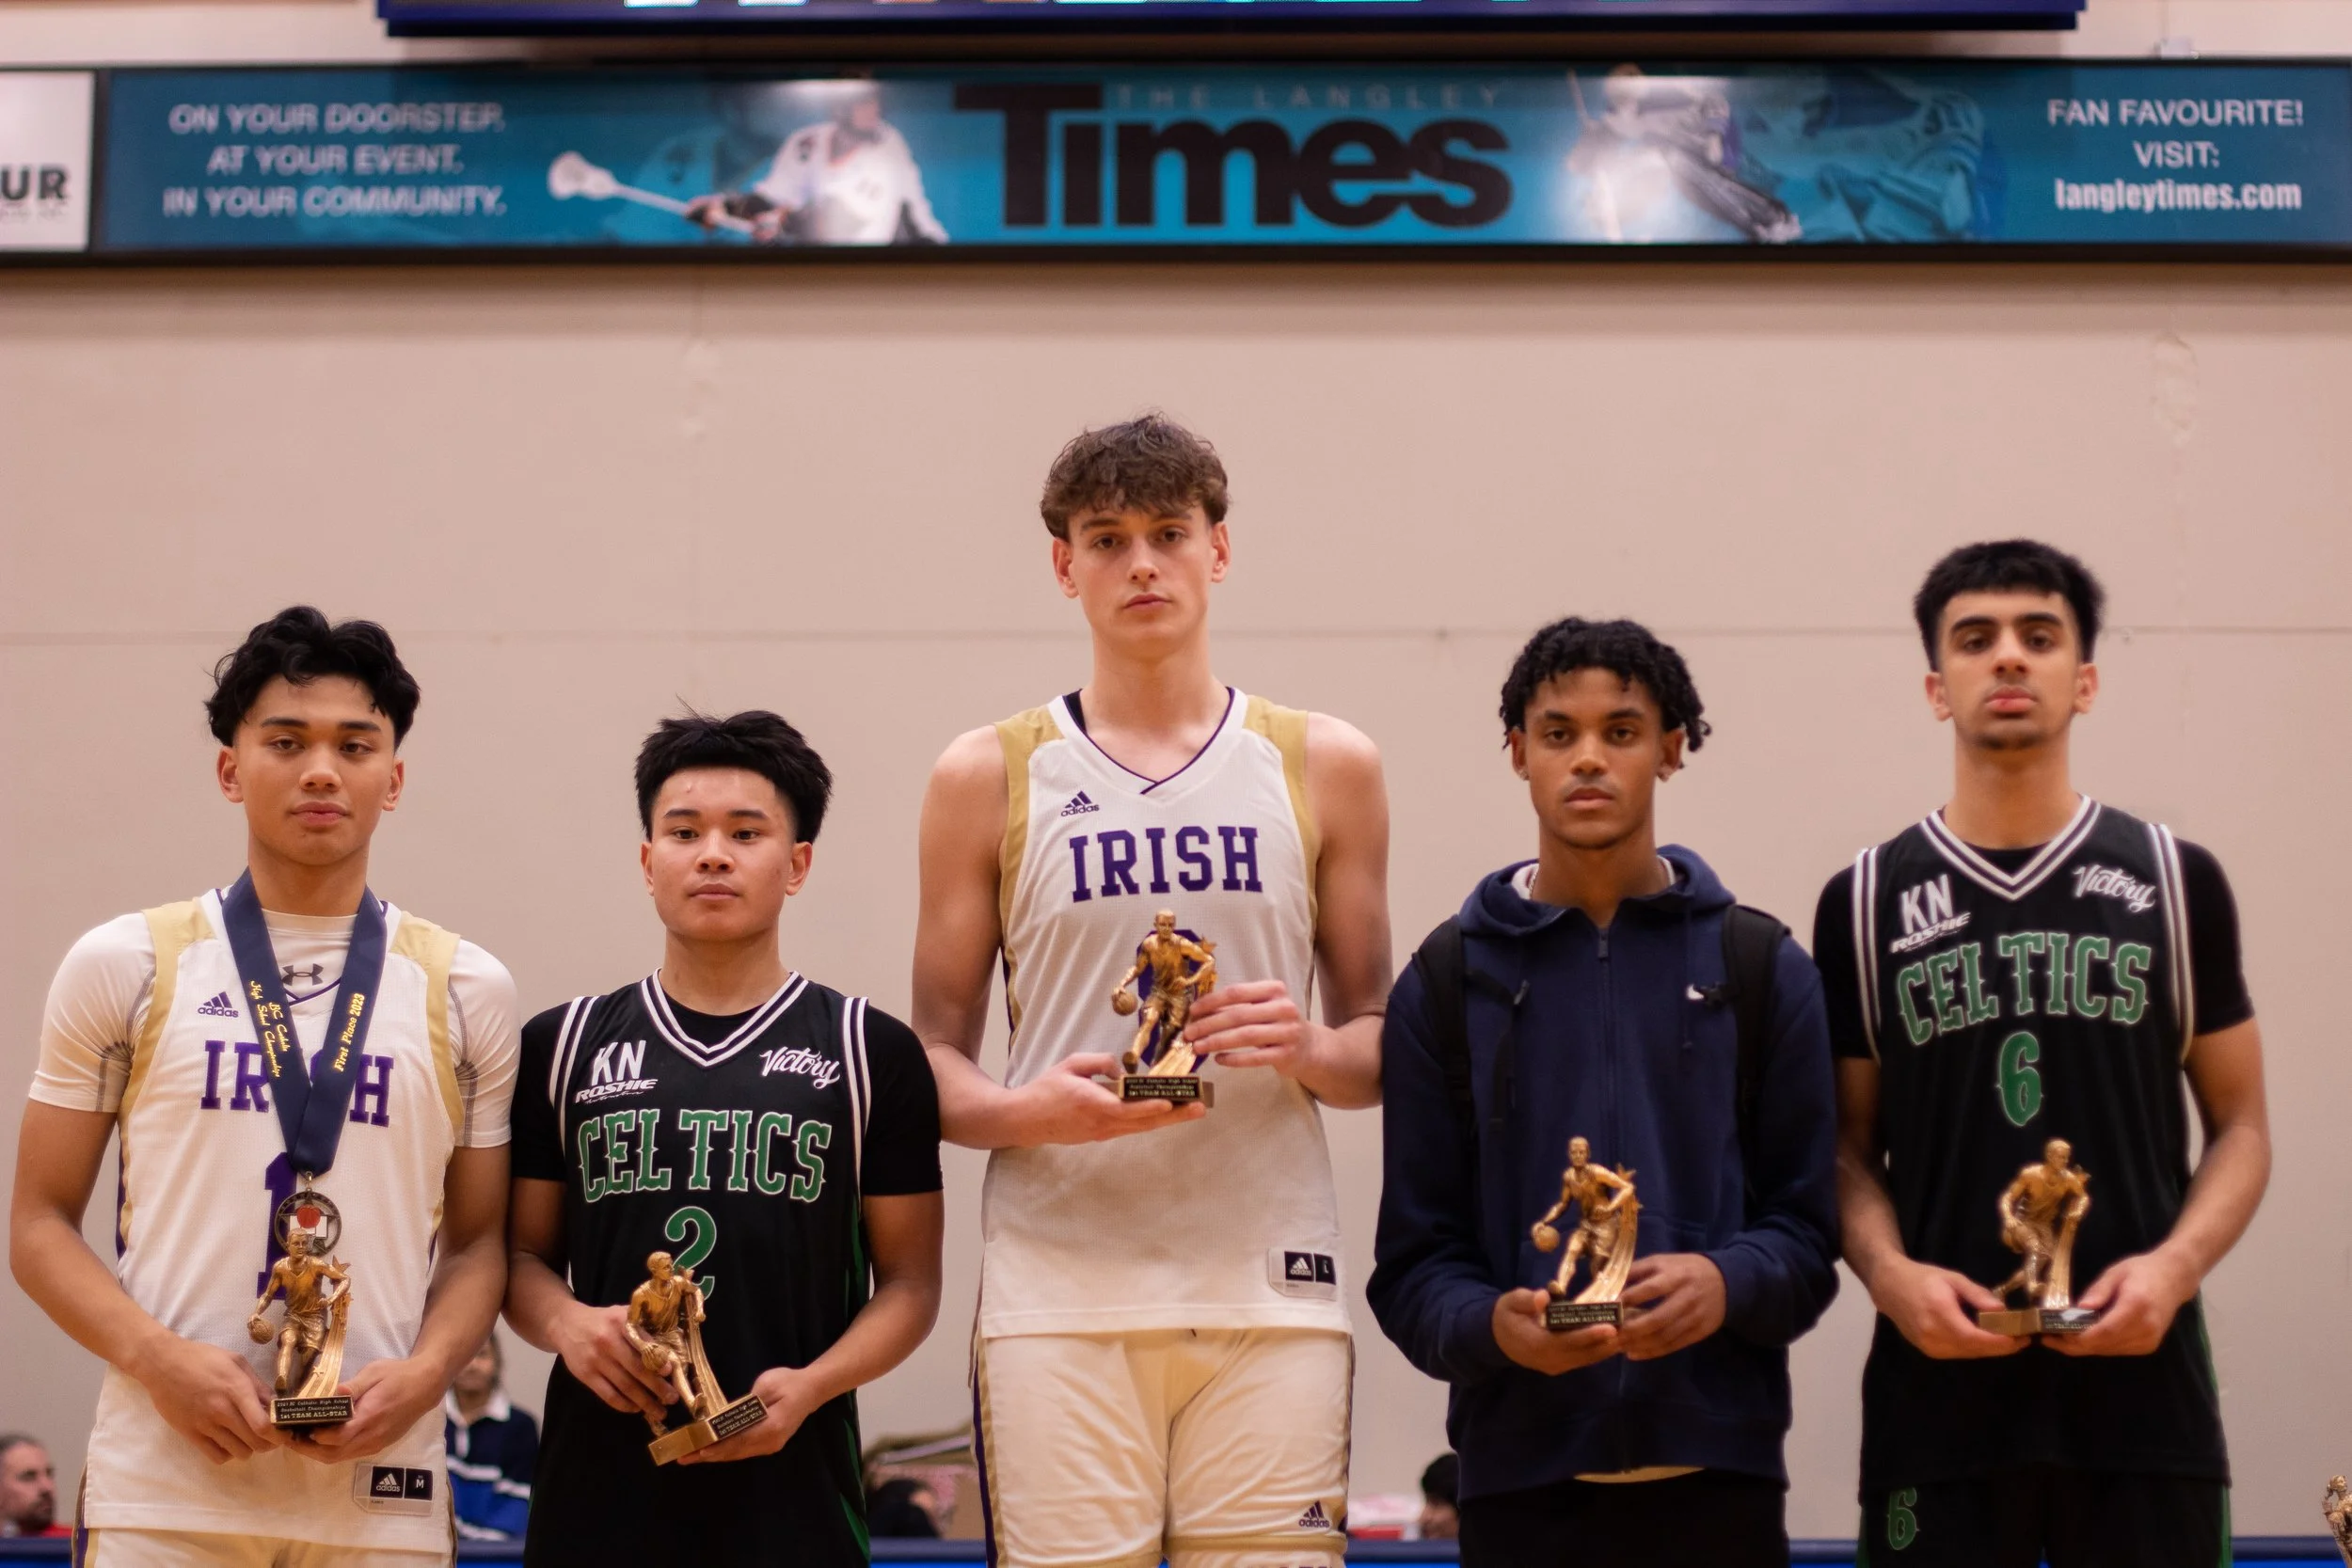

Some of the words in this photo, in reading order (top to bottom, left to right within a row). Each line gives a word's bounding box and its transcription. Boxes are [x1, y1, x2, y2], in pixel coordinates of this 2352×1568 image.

[1119, 84, 1211, 109] THE
[1253, 84, 1502, 109] LANGLEY
[2048, 99, 2109, 126] FAN
[2119, 99, 2305, 126] FAVOURITE!
[168, 103, 219, 134] ON
[227, 103, 319, 134] YOUR
[325, 103, 506, 134] DOORSTEP.
[206, 144, 249, 176] AT
[255, 144, 347, 176] YOUR
[354, 144, 464, 175] EVENT.
[954, 83, 1514, 230] Times
[2133, 140, 2220, 168] VISIT:
[0, 165, 69, 200] UR
[2055, 178, 2302, 214] langleytimes.com
[163, 185, 198, 218] IN
[204, 185, 297, 218] YOUR
[303, 185, 508, 218] COMMUNITY.
[1061, 803, 1100, 817] adidas
[1069, 825, 1263, 903] IRISH
[2073, 863, 2156, 912] Victory
[1900, 873, 1954, 935] KN
[1889, 911, 1972, 953] ROSHIE
[349, 992, 365, 1017] 2023
[1897, 932, 2153, 1045] CELTICS
[197, 1006, 239, 1018] adidas
[268, 1002, 284, 1020] BC
[342, 1017, 358, 1045] Place
[334, 1046, 349, 1072] First
[591, 1039, 647, 1086] KN
[759, 1046, 841, 1089] Victory
[201, 1039, 394, 1128] IRH
[575, 1079, 659, 1103] ROSHIE
[1995, 1031, 2044, 1127] 6
[578, 1108, 833, 1203] CELTICS
[664, 1206, 718, 1301] 2
[1290, 1268, 1312, 1276] adidas
[376, 1484, 401, 1493] adidas
[416, 1479, 424, 1489] M
[1298, 1518, 1330, 1528] adidas
[1886, 1486, 1920, 1551] 6
